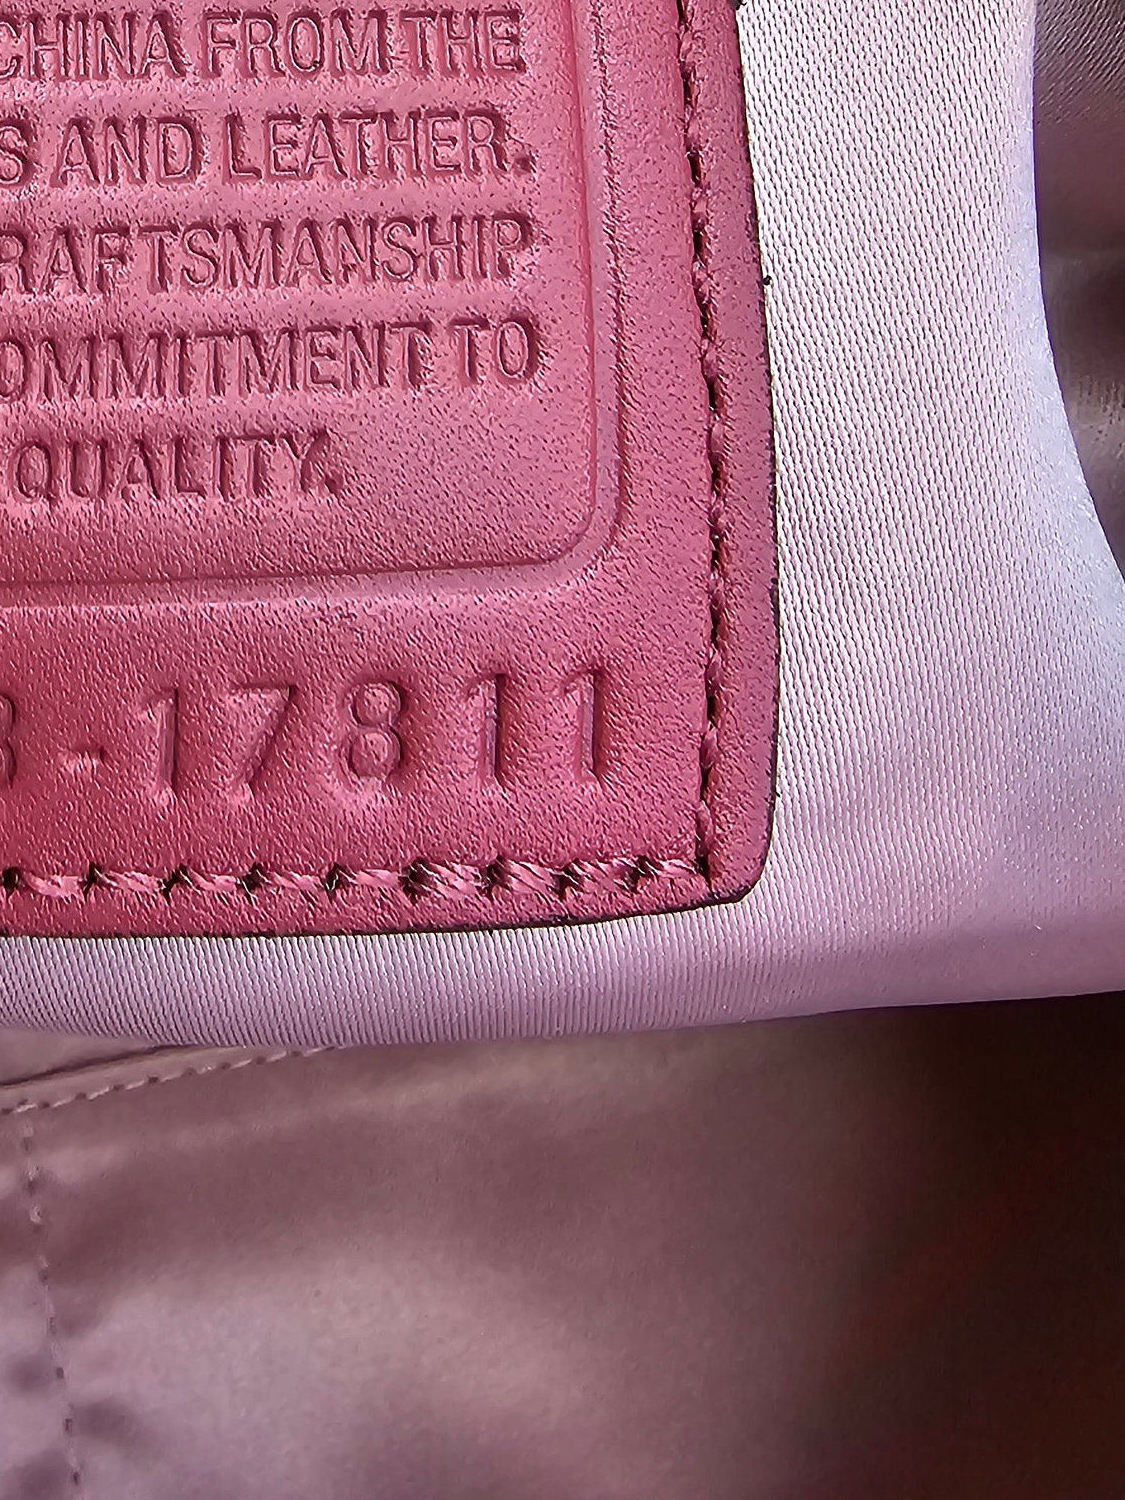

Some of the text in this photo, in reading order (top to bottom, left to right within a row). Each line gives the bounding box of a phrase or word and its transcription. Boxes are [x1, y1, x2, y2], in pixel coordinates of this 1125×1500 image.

[198, 6, 391, 80] FROM
[395, 4, 529, 74] THE
[55, 114, 209, 188] AND
[225, 106, 539, 182] LEATHER.
[447, 312, 543, 388] TO
[10, 428, 347, 508] QUALITY.
